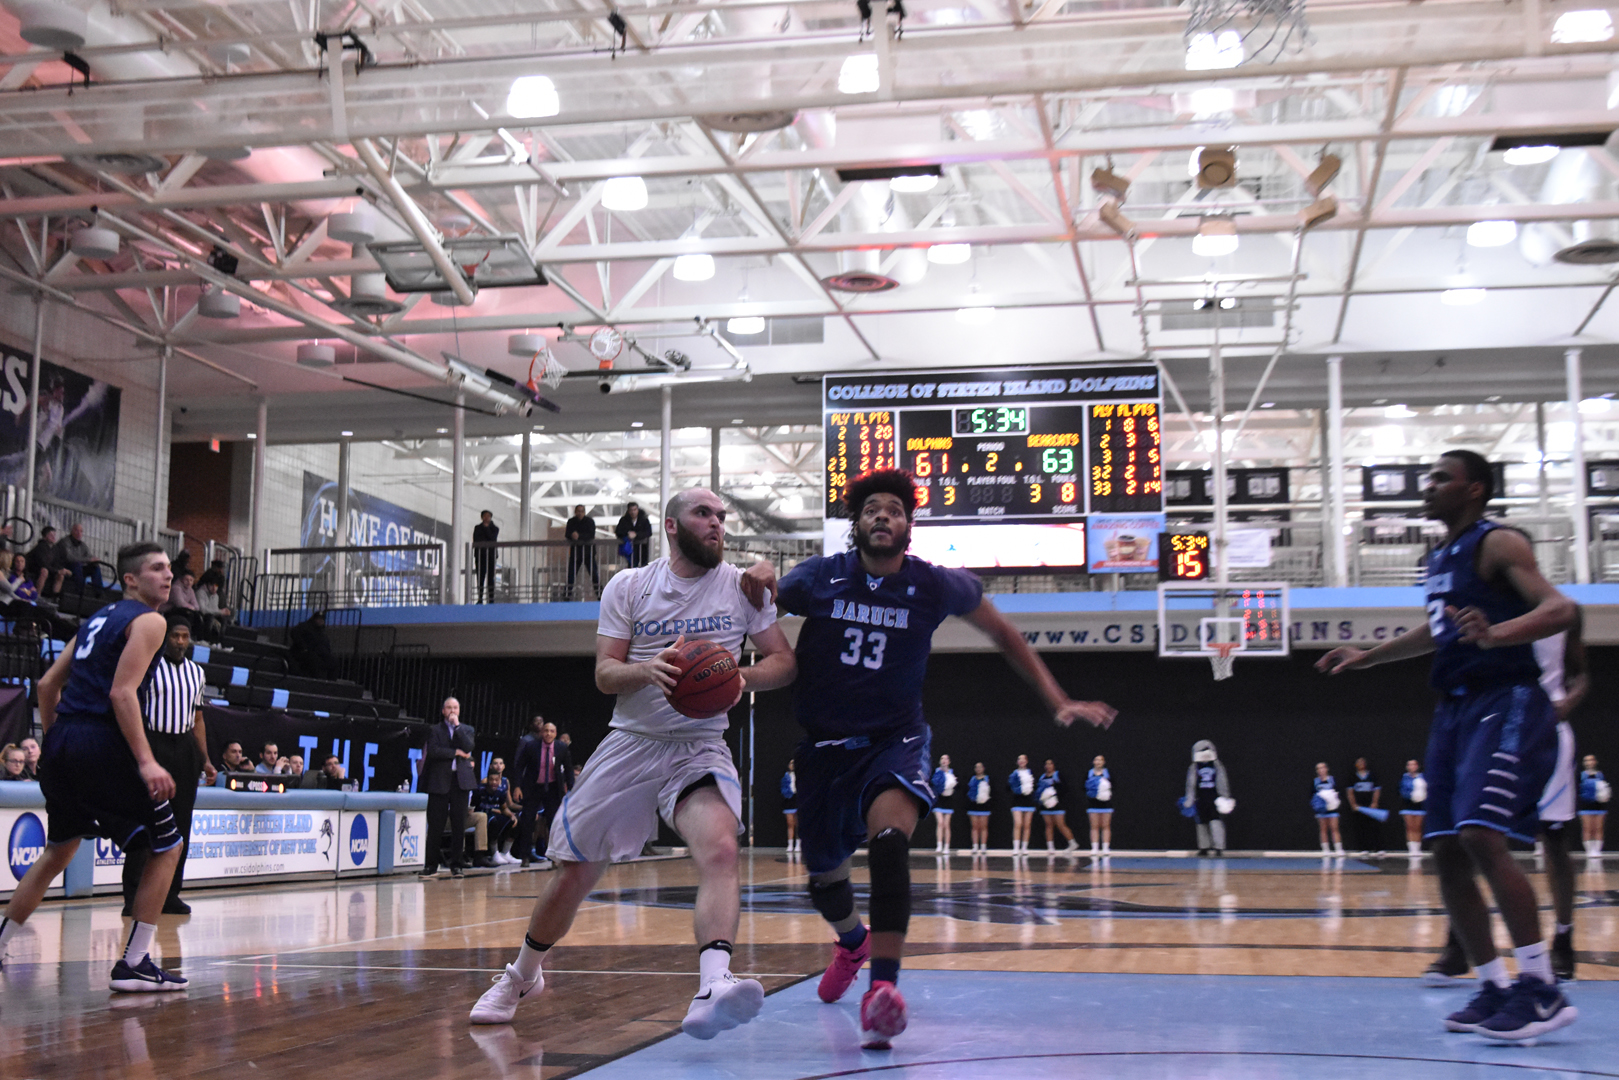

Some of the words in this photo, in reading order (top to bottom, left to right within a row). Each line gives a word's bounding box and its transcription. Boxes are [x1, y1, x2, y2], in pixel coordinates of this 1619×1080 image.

[0, 352, 27, 415] S
[828, 384, 909, 400] COLLEGE
[910, 383, 936, 398] OF
[1067, 375, 1157, 393] DOLPHINS
[869, 411, 890, 424] PTS
[971, 407, 1026, 433] 5:34
[1133, 403, 1156, 416] PTS
[838, 426, 847, 440] 2
[860, 425, 870, 440] 2
[874, 424, 893, 440] 20
[1027, 433, 1080, 447] BEARCATS
[1099, 433, 1110, 448] 2
[1126, 432, 1137, 447] 3
[838, 441, 847, 456] 3
[906, 437, 953, 450] DOLPHINS
[915, 452, 949, 477] 61
[985, 451, 998, 472] 2
[1042, 448, 1074, 473] 63
[1102, 449, 1112, 464] 3
[967, 475, 996, 486] PLAYER
[997, 475, 1017, 485] FOUL
[1051, 473, 1077, 483] FOULS
[943, 485, 956, 506] 3
[1030, 483, 1042, 503] 3
[1061, 482, 1075, 503] 8
[978, 506, 1005, 516] MATCH
[1177, 550, 1203, 577] 15
[830, 599, 910, 630] BARUCH
[633, 614, 733, 637] DOLPHINS
[75, 614, 108, 660] 3
[839, 627, 888, 670] 33
[692, 656, 738, 683] Wilson
[192, 813, 239, 836] COLLEGE
[239, 813, 253, 835] OF
[283, 813, 313, 833] ISLAND
[11, 846, 46, 867] NCAA
[204, 841, 225, 859] CITY
[224, 839, 269, 858] UNIVERSITY
[269, 839, 280, 855] OF
[279, 838, 297, 855] NEW
[297, 838, 317, 854] YORK
[402, 835, 419, 858] CSI
[224, 862, 285, 876] www.csidolphins.com
